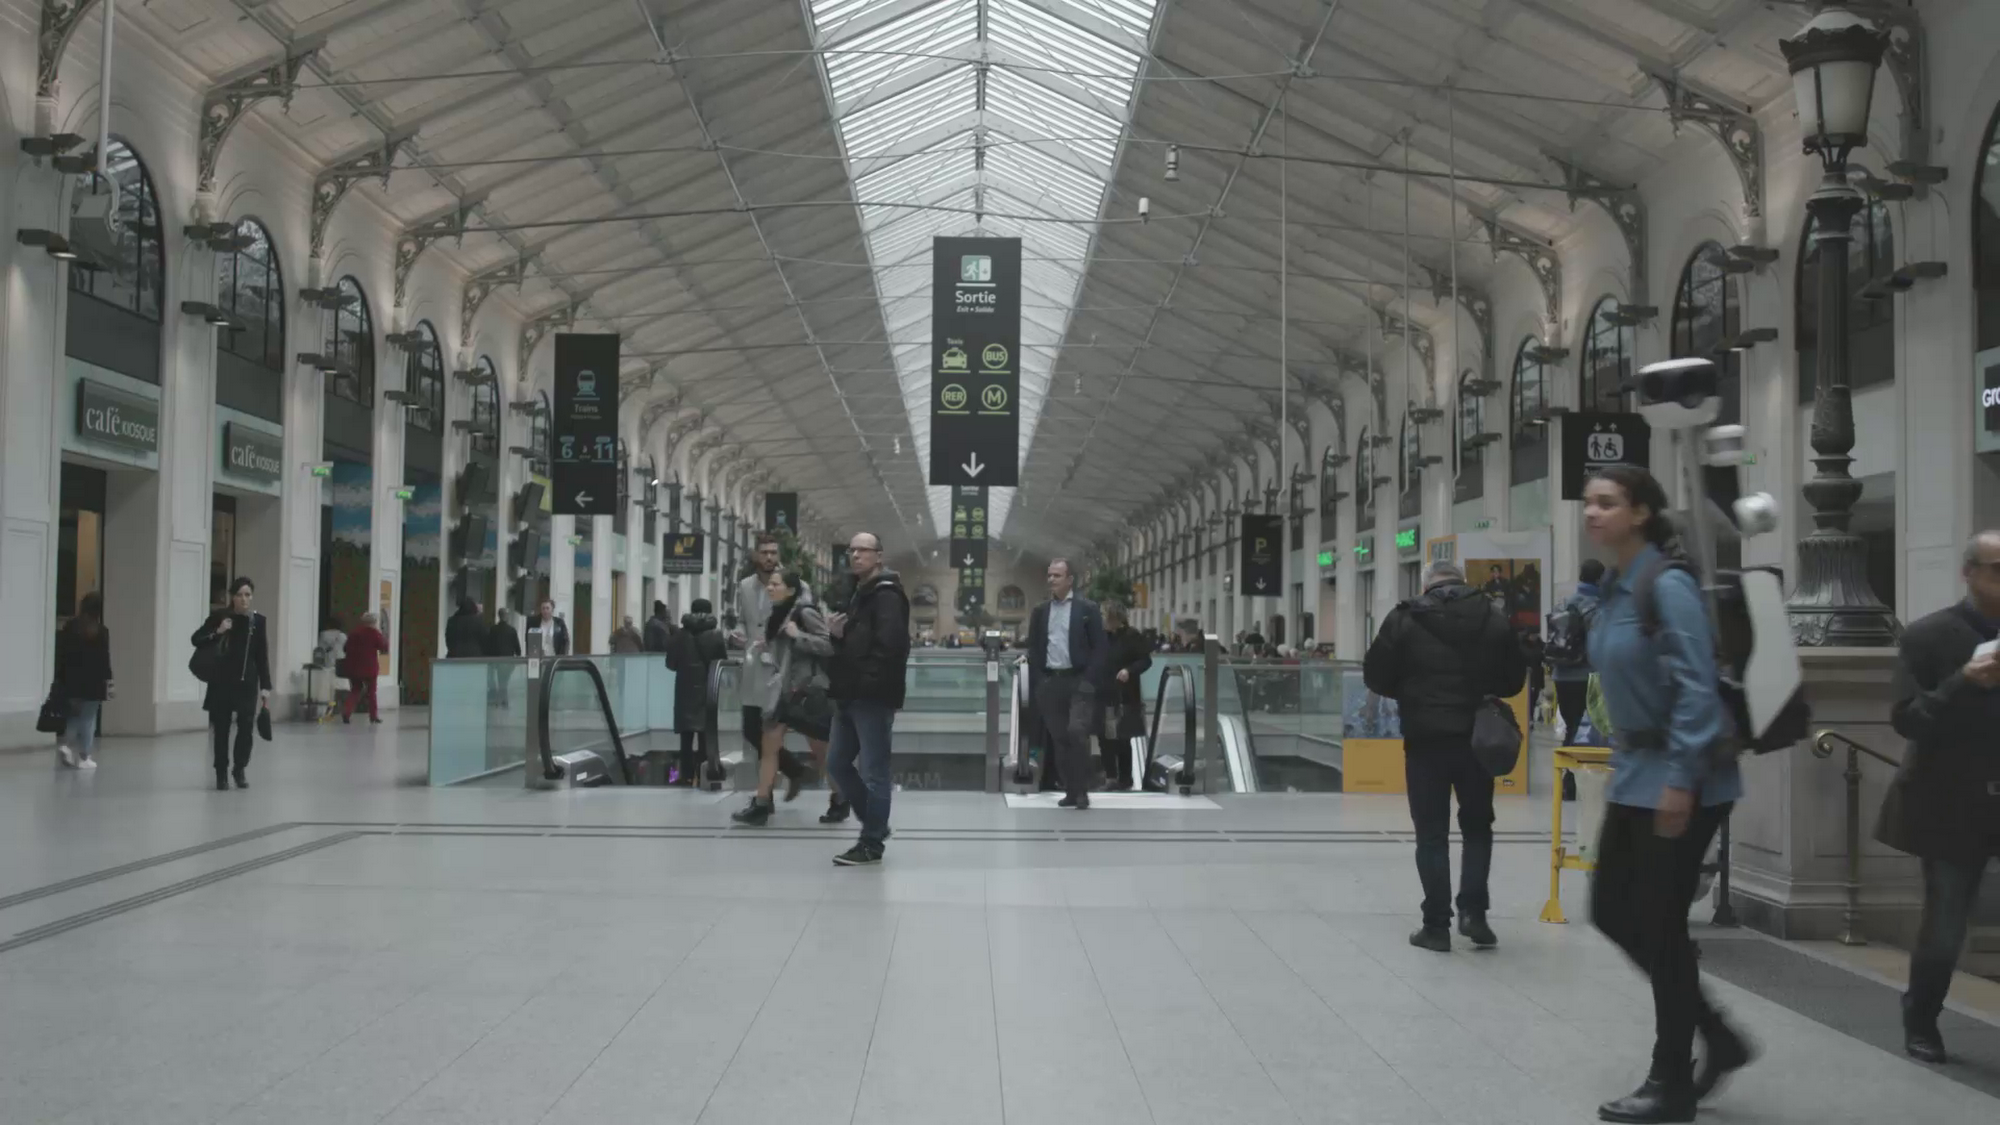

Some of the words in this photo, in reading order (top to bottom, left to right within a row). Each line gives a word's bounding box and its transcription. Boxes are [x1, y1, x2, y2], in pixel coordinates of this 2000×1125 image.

[955, 290, 997, 304] Sortie
[985, 351, 1005, 362] BUS
[945, 391, 964, 402] RER
[987, 389, 1002, 405] M
[574, 403, 599, 413] Trains
[86, 406, 120, 437] café
[121, 420, 155, 443] KIOSQUE
[561, 442, 573, 459] 6
[593, 442, 614, 459] 11
[231, 445, 255, 469] café
[256, 455, 280, 474] KIOSQUE
[1255, 537, 1267, 553] P
